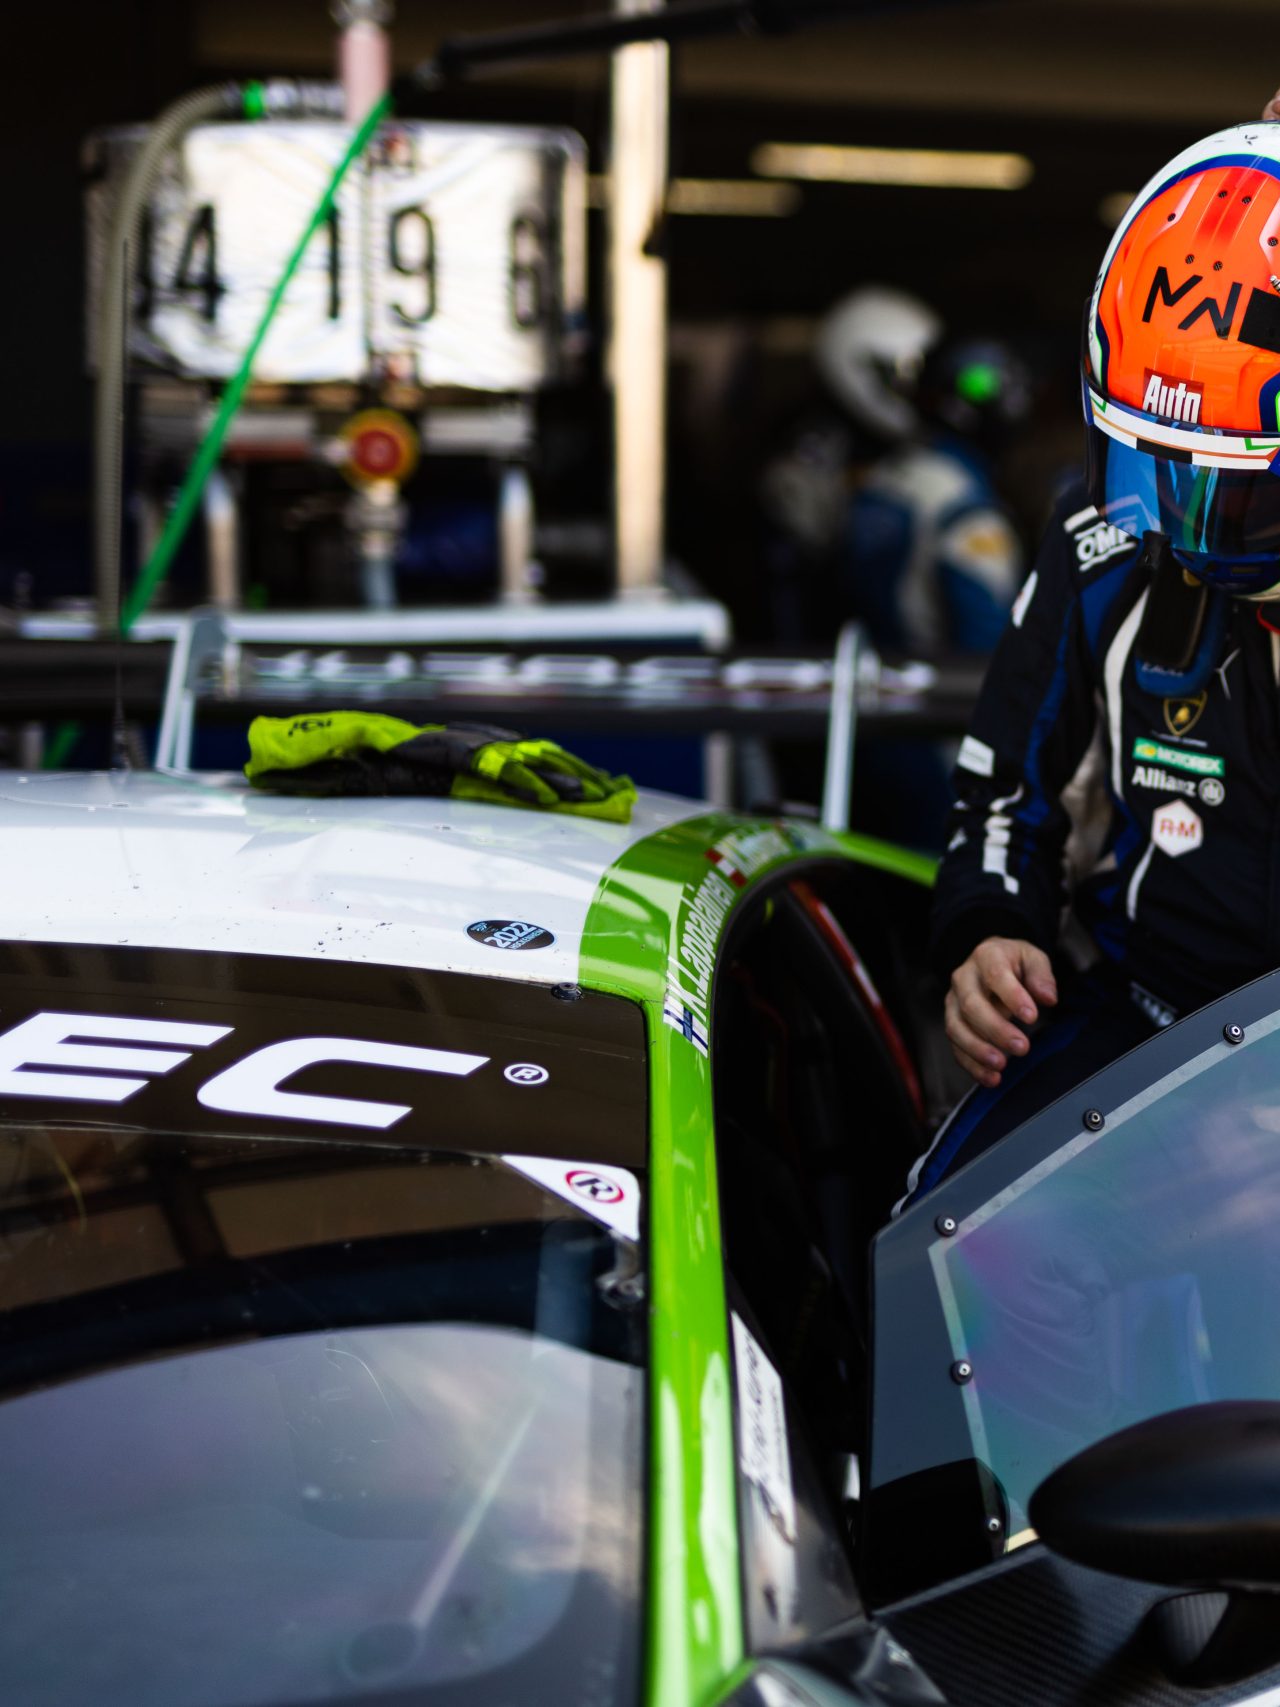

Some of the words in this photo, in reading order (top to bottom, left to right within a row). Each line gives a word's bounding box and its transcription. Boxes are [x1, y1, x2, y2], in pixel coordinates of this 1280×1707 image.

[1143, 374, 1202, 424] Auto
[1132, 765, 1197, 798] Allianz
[484, 922, 537, 948] 2022
